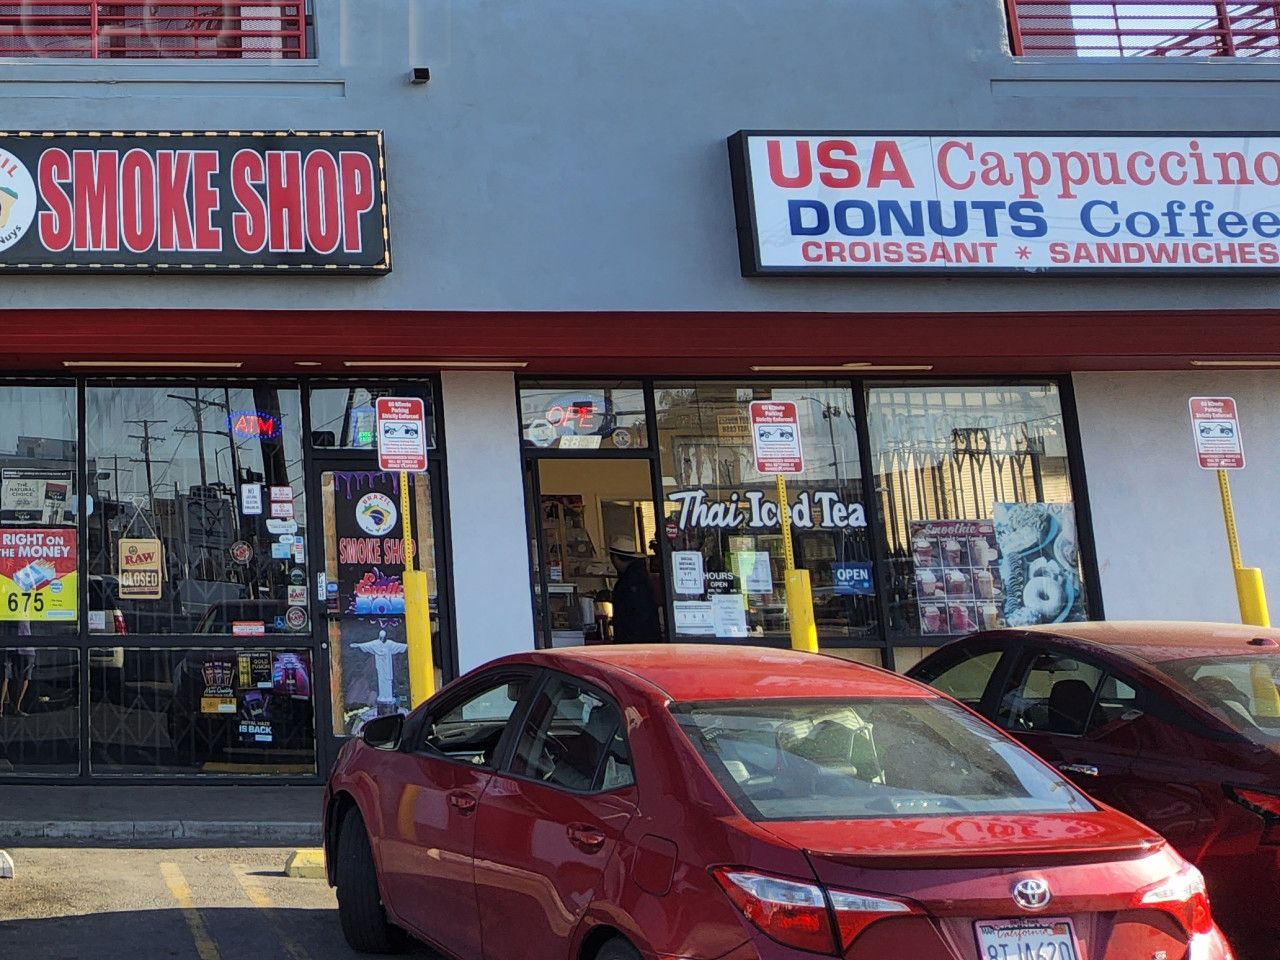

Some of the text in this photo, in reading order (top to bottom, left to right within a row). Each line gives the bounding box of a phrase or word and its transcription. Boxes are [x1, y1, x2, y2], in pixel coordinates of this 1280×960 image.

[766, 140, 1280, 199] USA Cappuccino
[38, 147, 375, 255] SMOKE SHOP
[788, 199, 1280, 238] DONUTS Coffee
[801, 240, 1280, 265] CROISSANT SANDWICHES
[235, 415, 274, 435] ATM
[362, 494, 391, 505] BRAZIL
[668, 490, 744, 530] Thai
[813, 491, 867, 528] Tea
[924, 523, 977, 535] Smoothie
[3, 534, 64, 546] RIGHT ON
[18, 546, 70, 558] MONEY
[340, 537, 381, 565] SMOKE
[125, 552, 156, 565] RAW
[123, 572, 157, 586] CLOSED
[703, 572, 734, 580] HOURS
[837, 569, 869, 580] OPEN
[249, 725, 272, 734] BACK
[996, 926, 1049, 940] California
